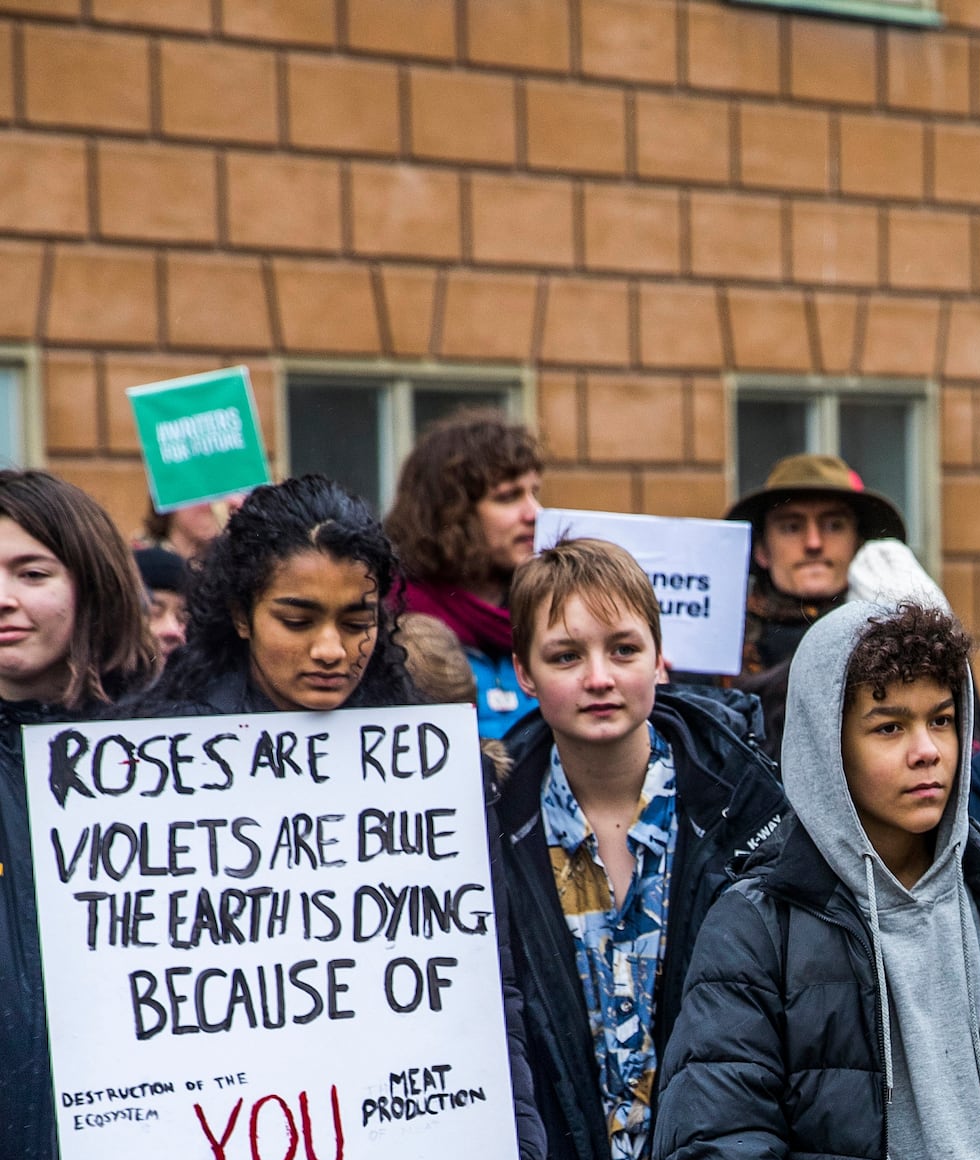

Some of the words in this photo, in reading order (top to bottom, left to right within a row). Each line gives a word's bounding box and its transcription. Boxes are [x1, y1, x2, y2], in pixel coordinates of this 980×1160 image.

[652, 572, 711, 592] ners
[659, 596, 710, 618] ure!
[48, 727, 240, 809] ROSES
[250, 730, 331, 784] ARE
[360, 722, 449, 783] RED
[50, 817, 263, 884] VIOLETS
[269, 812, 348, 870] ARE
[357, 807, 460, 863] BLUE
[73, 888, 159, 951] THE
[168, 886, 290, 950] EARTH
[300, 888, 342, 942] IS
[353, 882, 492, 943] DYING
[129, 958, 356, 1041] BECAUSE
[384, 956, 459, 1013] OF
[62, 1082, 175, 1108] DESTRUCTION
[186, 1079, 205, 1091] OF
[213, 1071, 249, 1090] THE
[389, 1064, 453, 1098] MEAT
[74, 1107, 159, 1130] ECOSYSTEM
[362, 1087, 487, 1127] PRODUCTION
